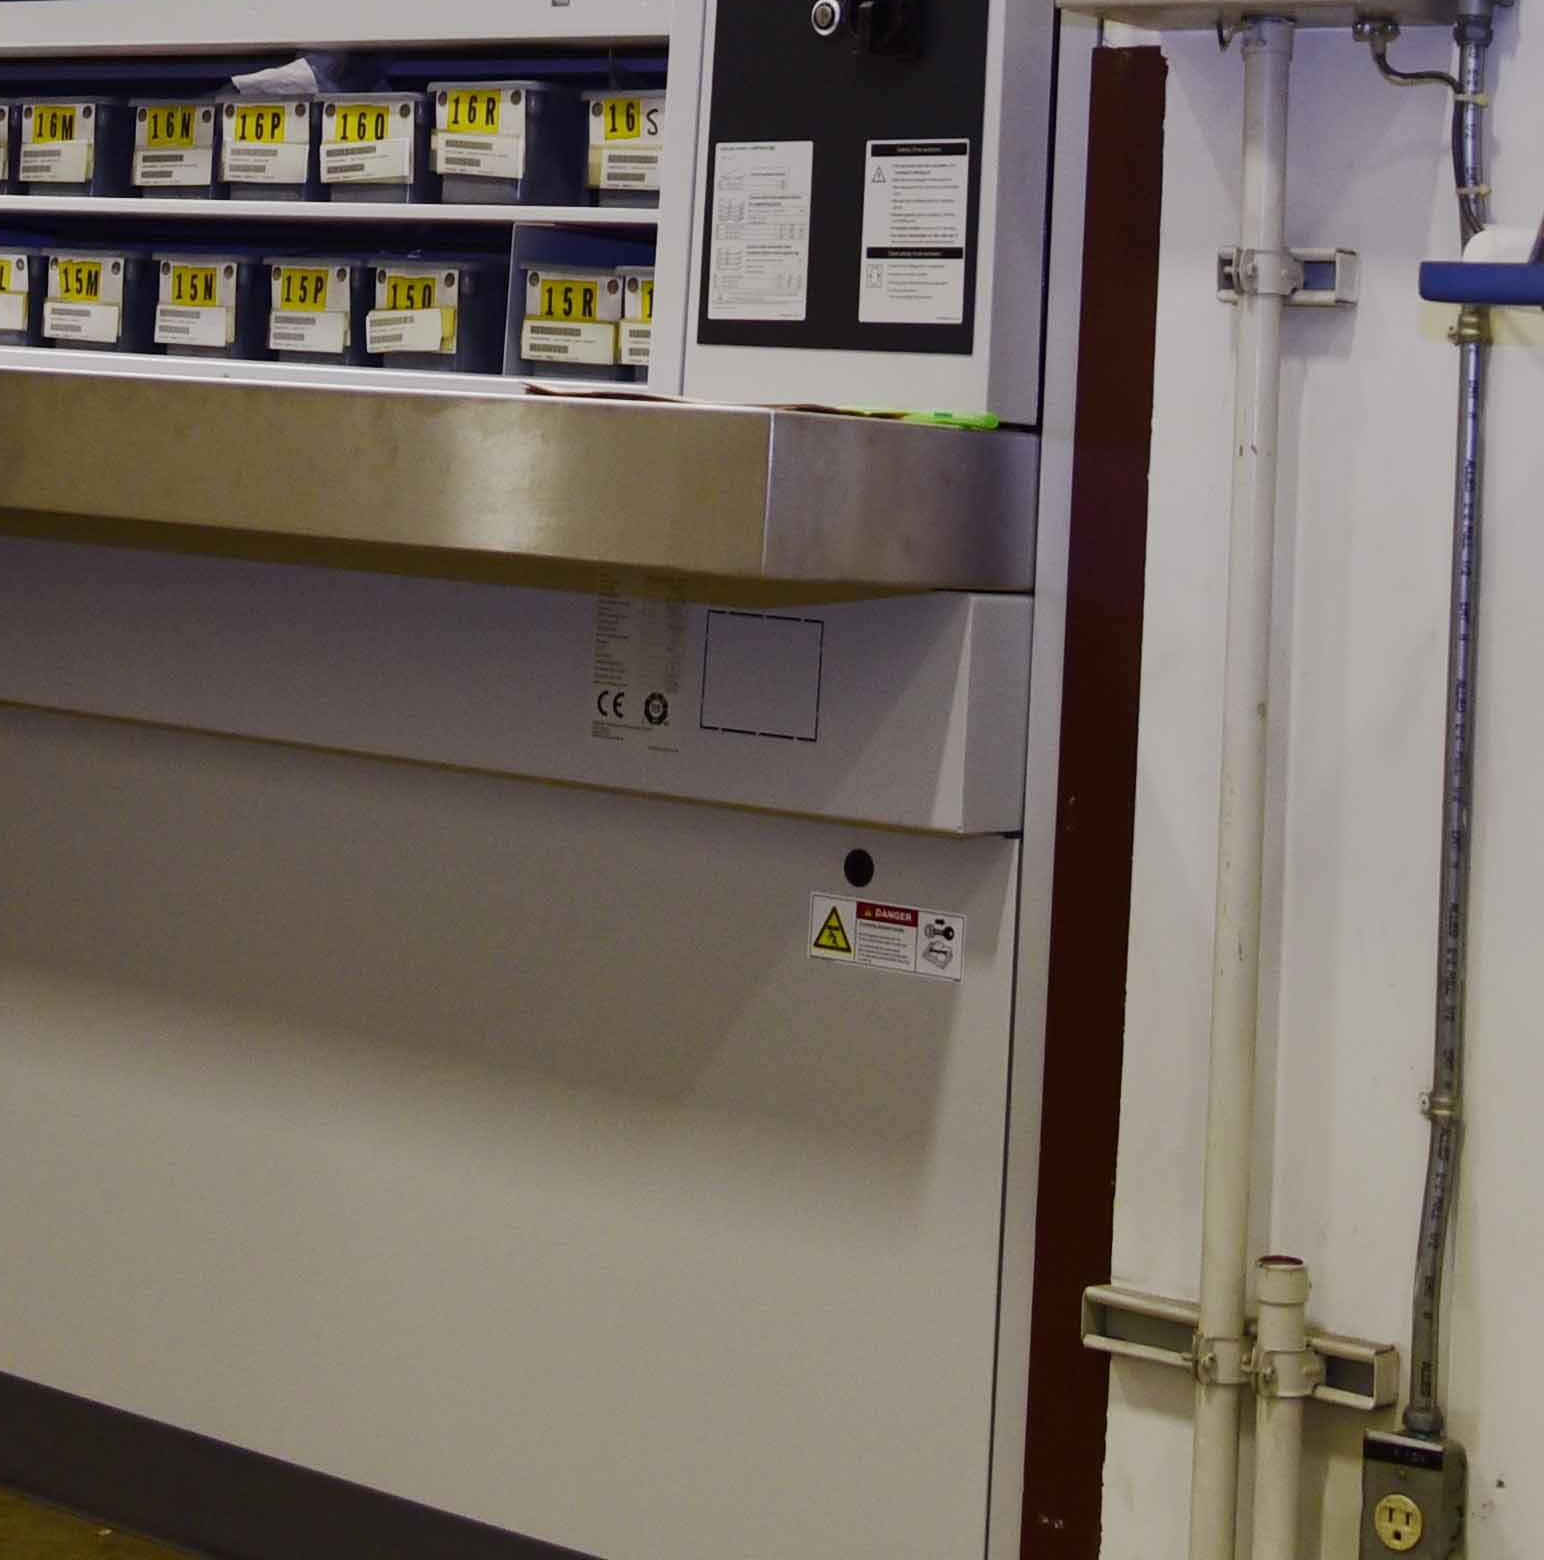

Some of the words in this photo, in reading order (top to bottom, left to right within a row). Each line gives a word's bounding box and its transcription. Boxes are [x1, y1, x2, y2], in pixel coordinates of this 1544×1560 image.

[452, 94, 497, 126] 16R
[37, 112, 74, 141] 16M
[151, 112, 191, 140] 16N
[239, 112, 281, 140] 16P
[63, 267, 99, 297] 15M
[175, 272, 213, 301] 15N
[284, 275, 325, 304] 15P
[545, 286, 594, 318] 15R
[874, 907, 912, 922] DANGER
